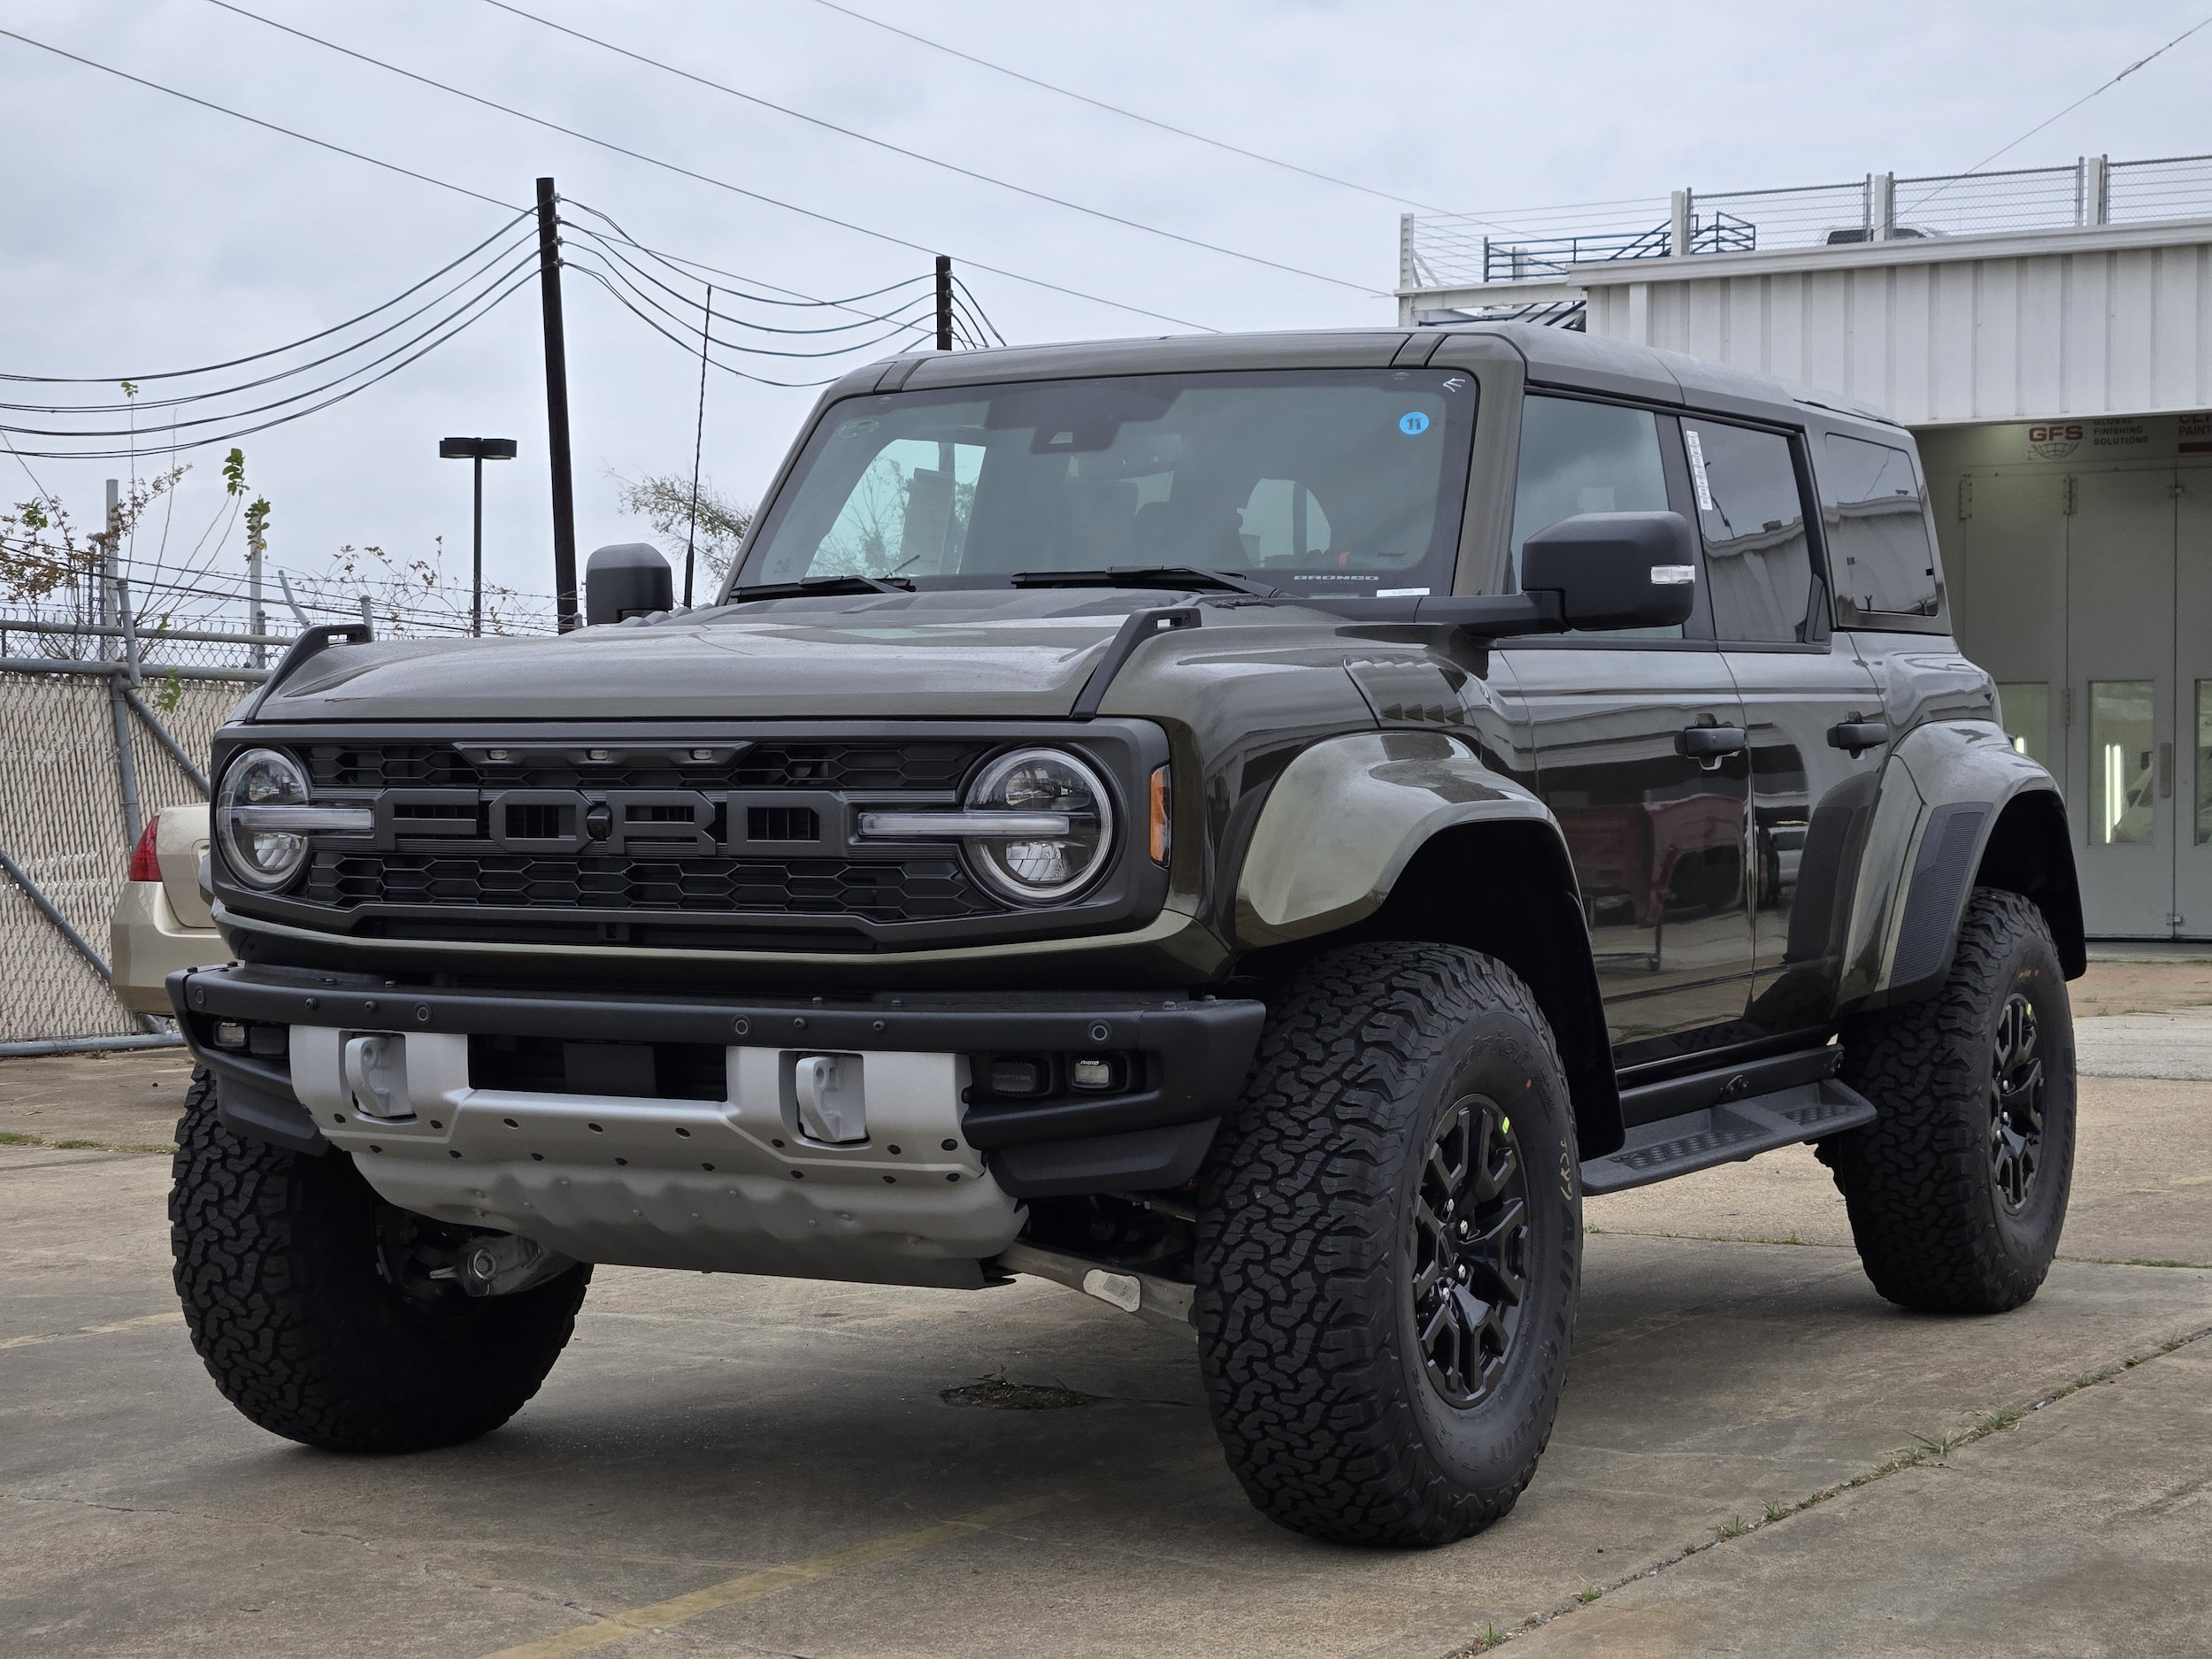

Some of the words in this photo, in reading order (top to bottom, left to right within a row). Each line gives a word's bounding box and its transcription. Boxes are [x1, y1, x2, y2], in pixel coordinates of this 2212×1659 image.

[1407, 418, 1421, 430] 11
[2029, 426, 2083, 442] GFS
[2093, 426, 2143, 435] FINISHING
[2093, 435, 2149, 446] SOLUTIONS
[376, 788, 847, 856] FORD
